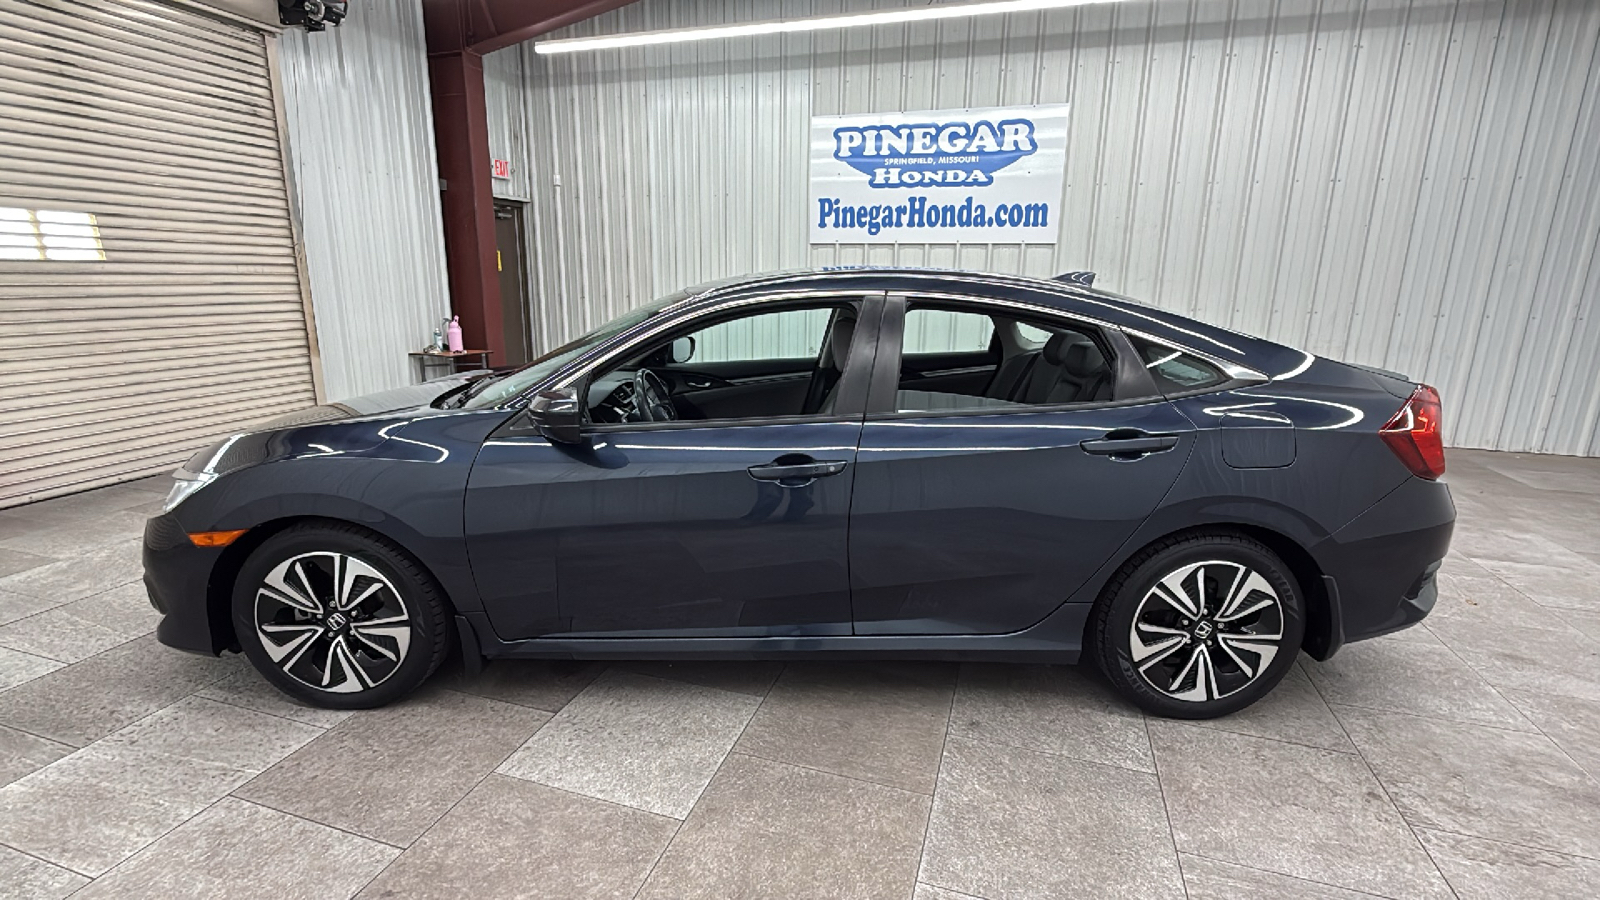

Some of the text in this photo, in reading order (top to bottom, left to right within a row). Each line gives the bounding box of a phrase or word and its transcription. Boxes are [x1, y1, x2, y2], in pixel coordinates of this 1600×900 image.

[837, 123, 1033, 157] PINEGAR
[494, 159, 509, 178] EXIT
[884, 155, 979, 166] SPRINGFIELD, MISSOURI
[873, 167, 989, 184] HONDA
[818, 196, 1049, 235] PinegarHonda.com
